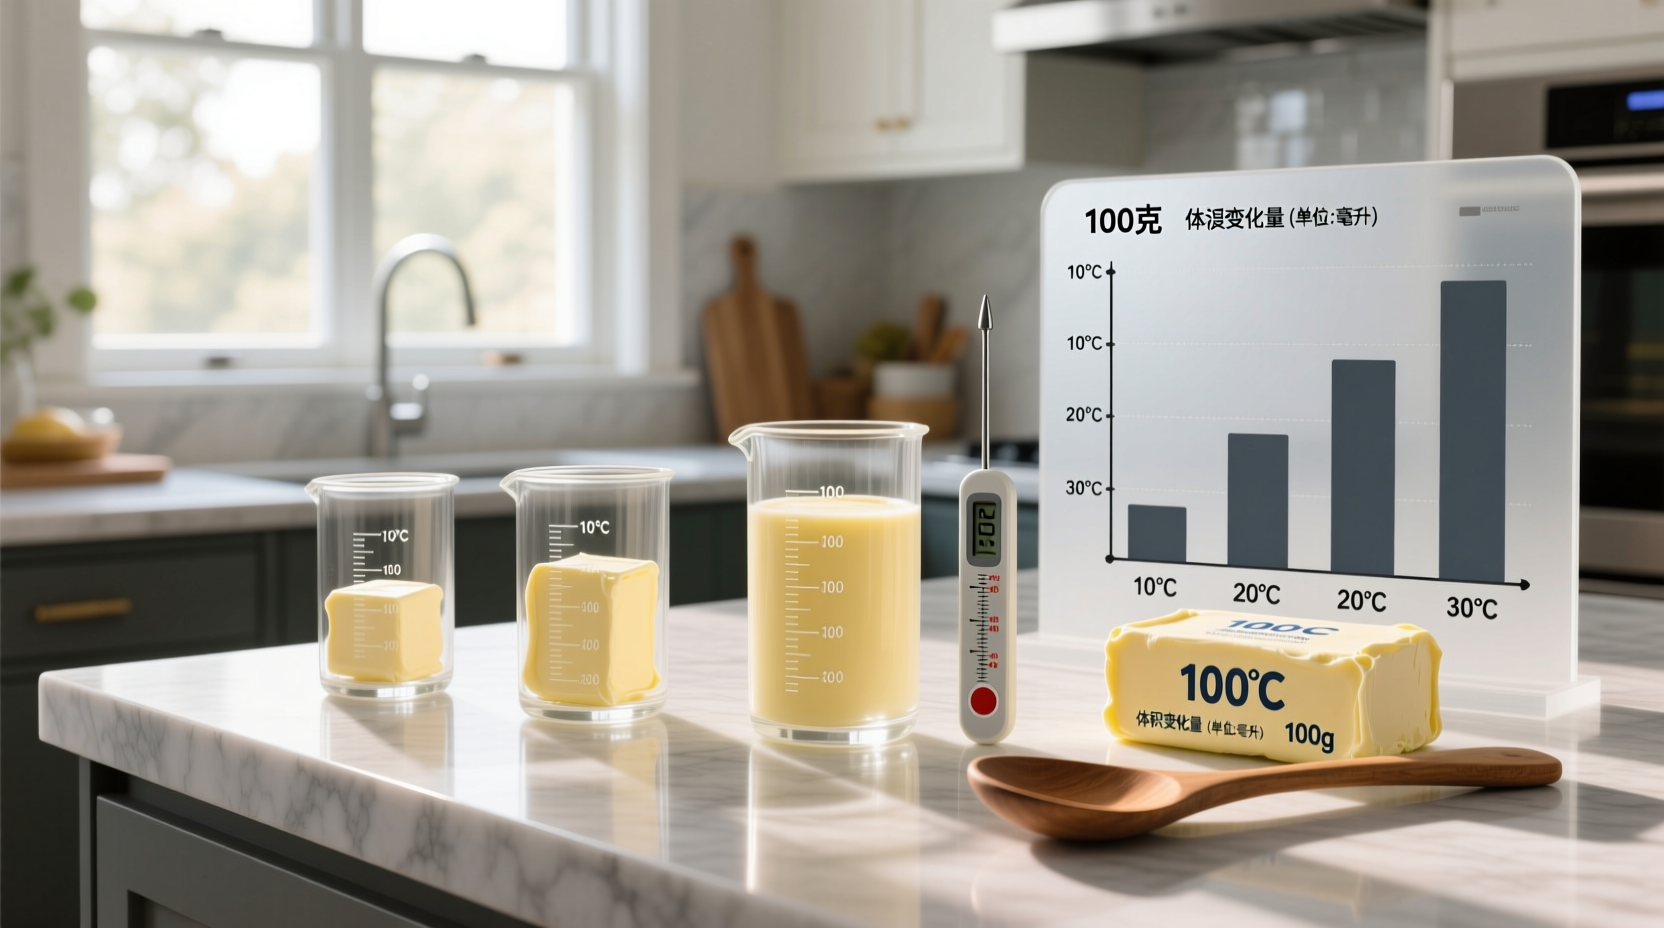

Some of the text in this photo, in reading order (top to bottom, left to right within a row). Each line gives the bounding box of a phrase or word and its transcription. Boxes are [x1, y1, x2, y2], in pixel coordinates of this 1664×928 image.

[1085, 204, 1163, 235] 100克
[819, 485, 845, 499] 100
[1285, 722, 1335, 754] 100g
